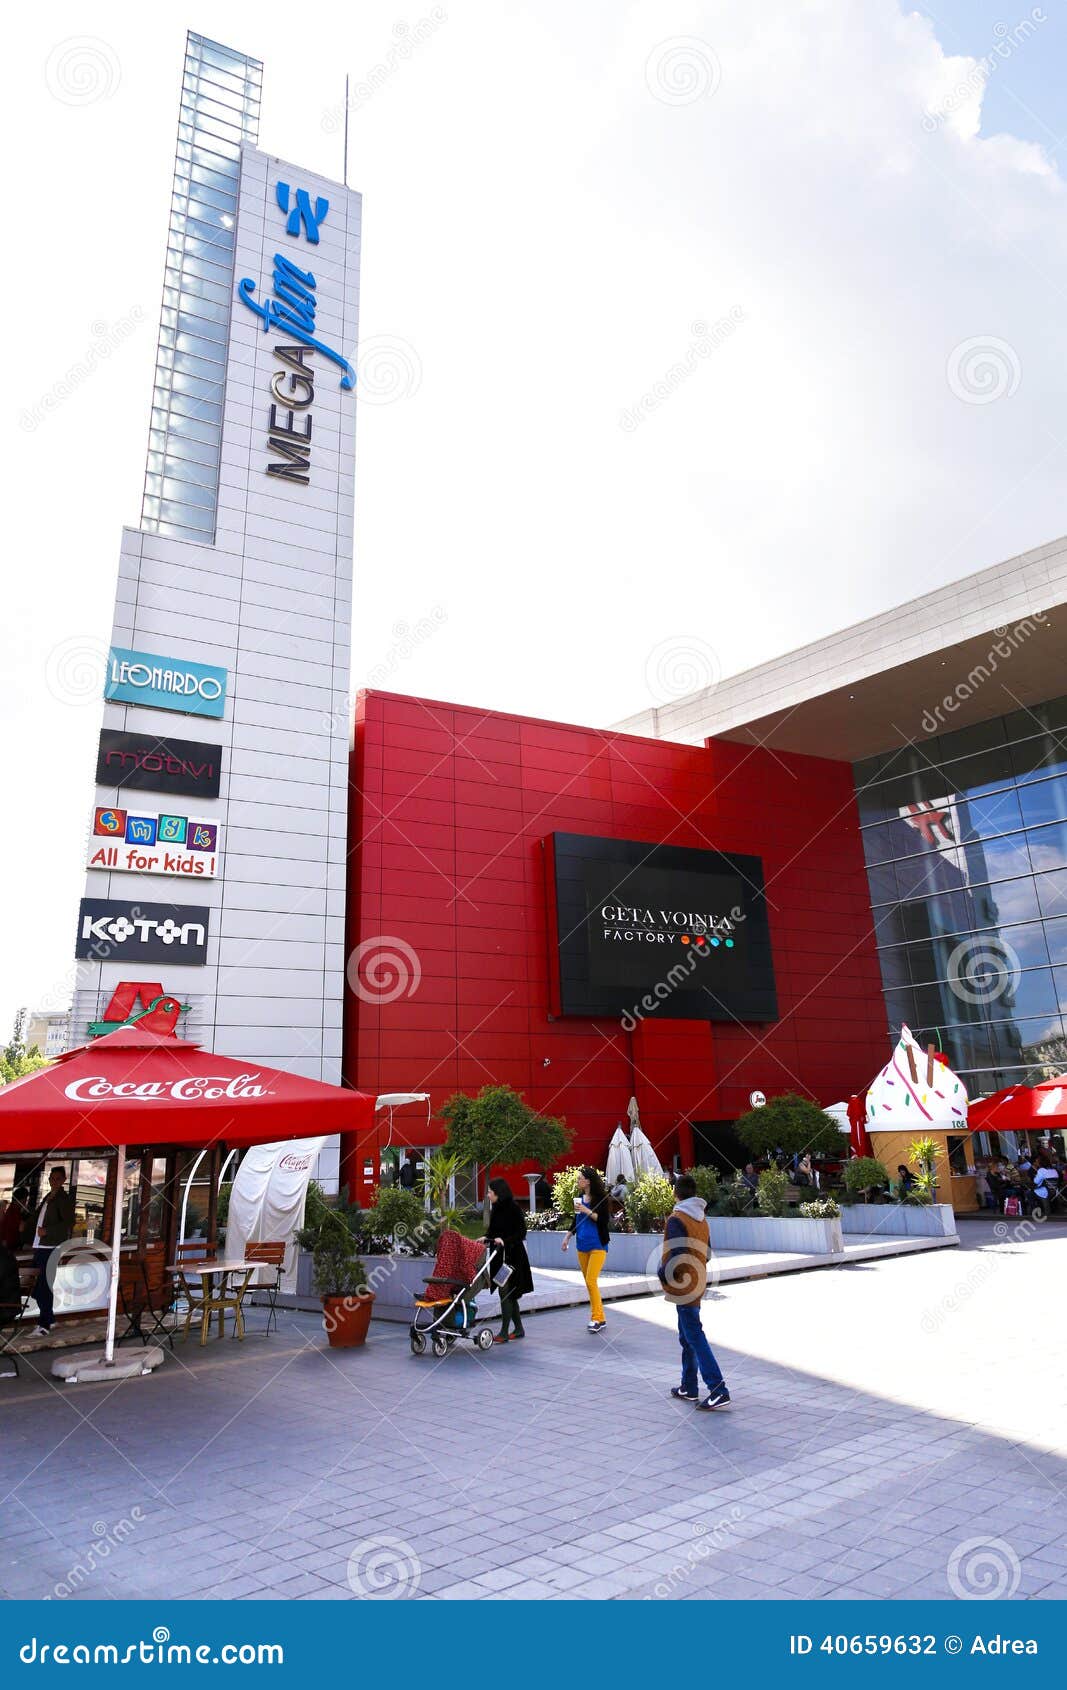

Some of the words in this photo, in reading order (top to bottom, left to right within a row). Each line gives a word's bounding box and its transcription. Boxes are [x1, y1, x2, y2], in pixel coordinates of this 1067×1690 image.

[239, 253, 356, 390] fun
[266, 346, 316, 485] MEGA
[111, 659, 222, 699] LEONARDO
[90, 847, 118, 866] All
[126, 849, 158, 869] for
[164, 852, 204, 874] kids
[82, 916, 205, 945] KOTON
[601, 905, 656, 924] GETA
[660, 910, 732, 930] VOINEA
[604, 929, 675, 943] FACTORY
[64, 1073, 268, 1101] Coca-Cola
